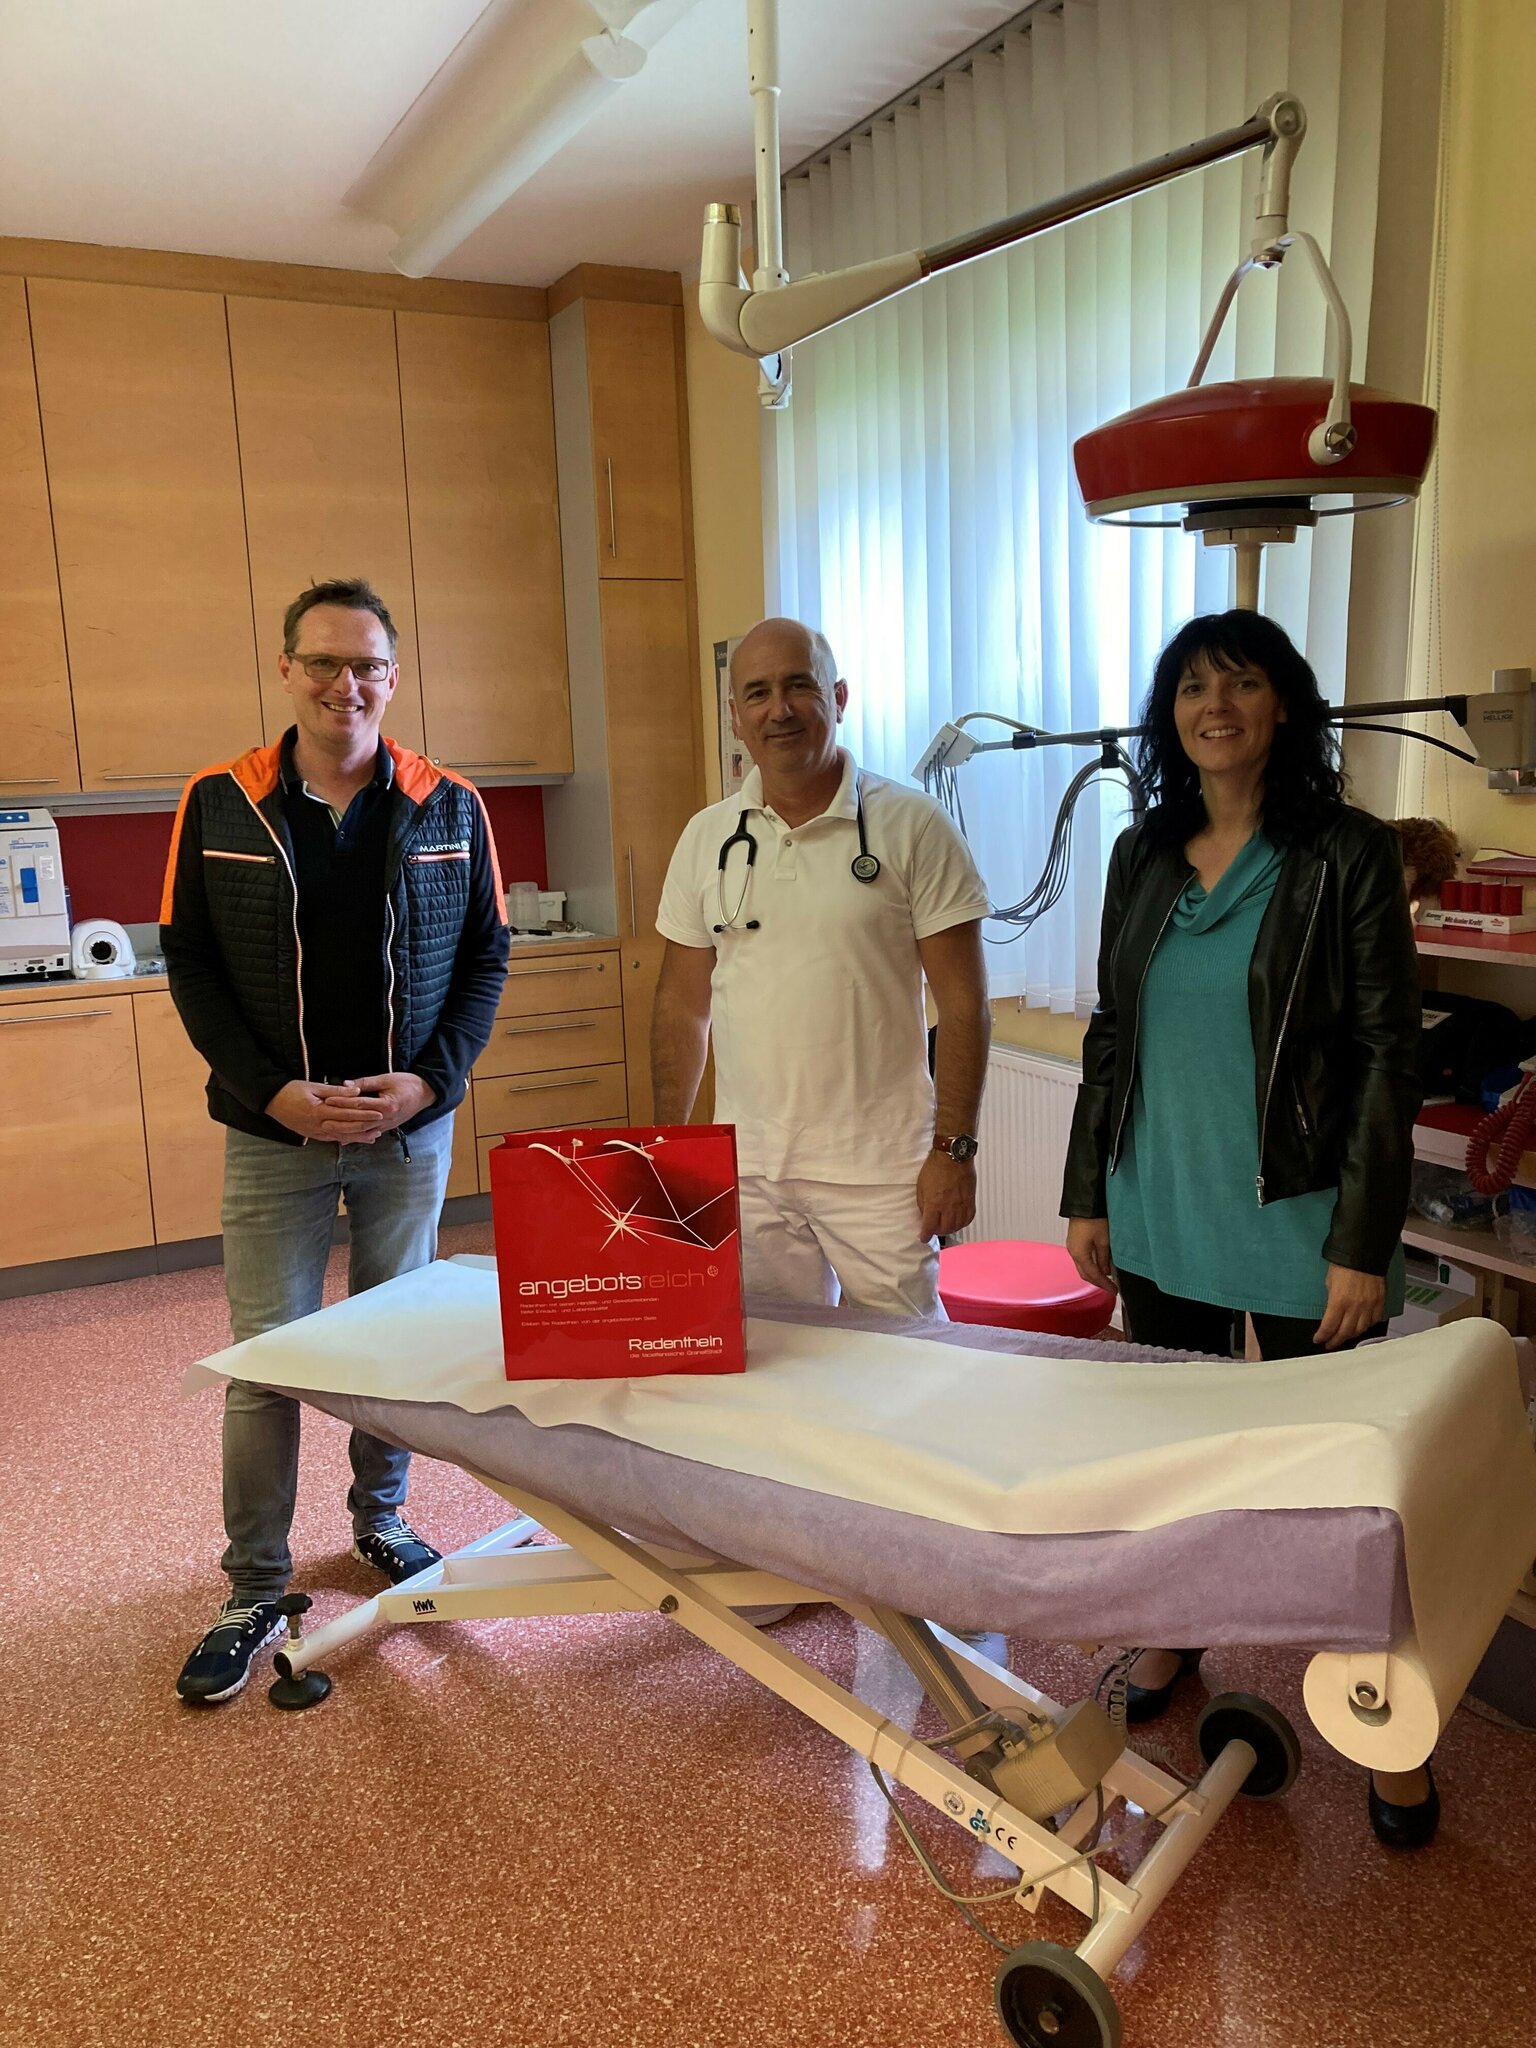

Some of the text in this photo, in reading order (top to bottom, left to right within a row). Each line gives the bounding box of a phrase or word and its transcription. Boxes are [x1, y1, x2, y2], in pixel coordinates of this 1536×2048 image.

[419, 842, 461, 852] MARTINI
[519, 1268, 705, 1299] angebotsreich
[628, 1335, 723, 1351] Radenthein
